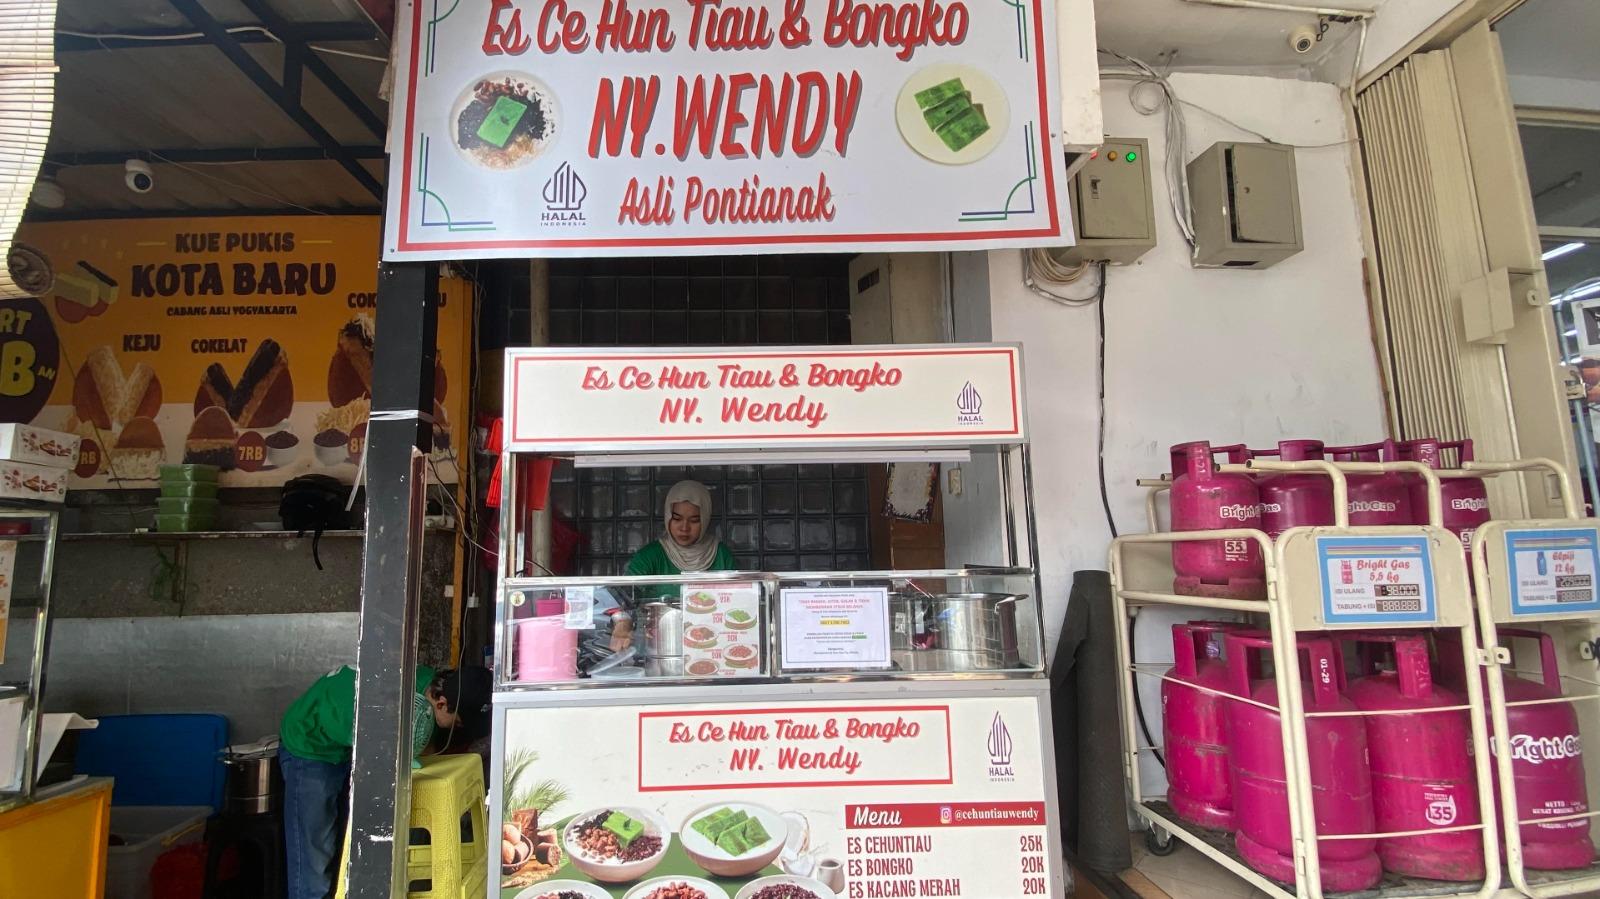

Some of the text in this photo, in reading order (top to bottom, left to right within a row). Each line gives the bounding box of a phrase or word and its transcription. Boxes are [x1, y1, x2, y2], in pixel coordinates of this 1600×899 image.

[481, 0, 970, 62] Es Ce Hun Tiau & Bongko
[588, 70, 863, 161] NY.WENDY
[618, 171, 836, 226] Asli Pontianak
[541, 212, 587, 221] HALAL
[175, 232, 295, 253] KUE PUKIS
[131, 261, 336, 298] KOTA BARU
[347, 292, 377, 308] COK
[167, 305, 297, 317] CABANG ASLI YOGYAKARTA
[123, 334, 161, 352] KEJU
[191, 338, 247, 354] COKELAT
[580, 361, 902, 392] Es Ce Hun Tiau & Bongko
[659, 394, 828, 429] NY. Wendy
[80, 451, 97, 465] RB
[238, 444, 264, 461] 7RB
[1220, 504, 1257, 521] Bright
[1370, 501, 1396, 512] Gas
[1356, 559, 1410, 571] Bright Gas
[1369, 571, 1400, 583] 5,5 kg
[1320, 658, 1330, 684] 01-29
[669, 716, 921, 744] Es Ce Hun Tiau & Bongko
[1490, 734, 1564, 764] right
[729, 745, 862, 775] NY. Wendy
[989, 766, 1014, 776] HALAL
[853, 806, 1039, 826] Menu @cehuntiauwendy
[1428, 806, 1453, 821] 135
[847, 835, 1043, 854] ES CEHUNTIAU 25K
[848, 856, 1044, 877] ES BONGKO 20K
[849, 878, 1046, 899] ES KACANG MERAH 20K
